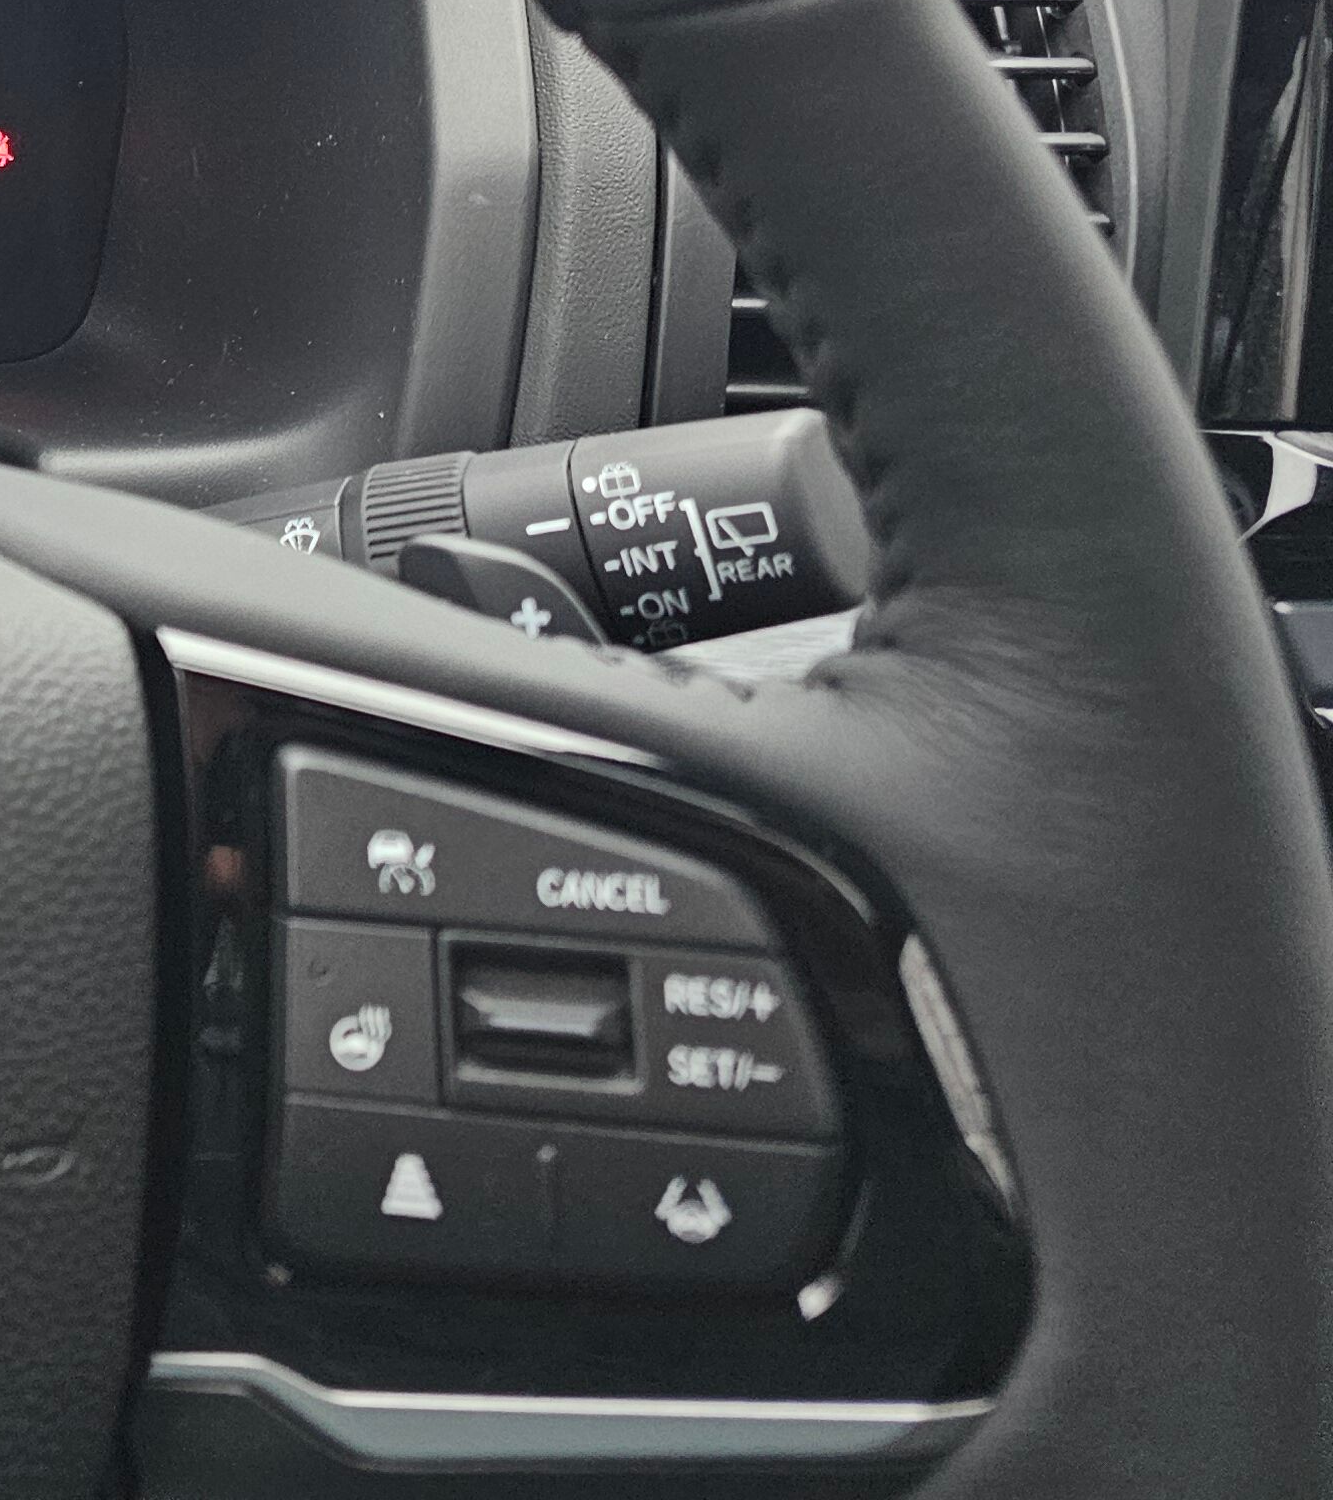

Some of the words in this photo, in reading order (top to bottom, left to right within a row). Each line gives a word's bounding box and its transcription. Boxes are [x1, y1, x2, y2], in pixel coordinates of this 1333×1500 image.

[608, 491, 674, 530] OFF
[621, 541, 679, 577] INT
[717, 554, 794, 584] REAR
[637, 588, 688, 621] ON
[536, 867, 671, 915] CANCEL
